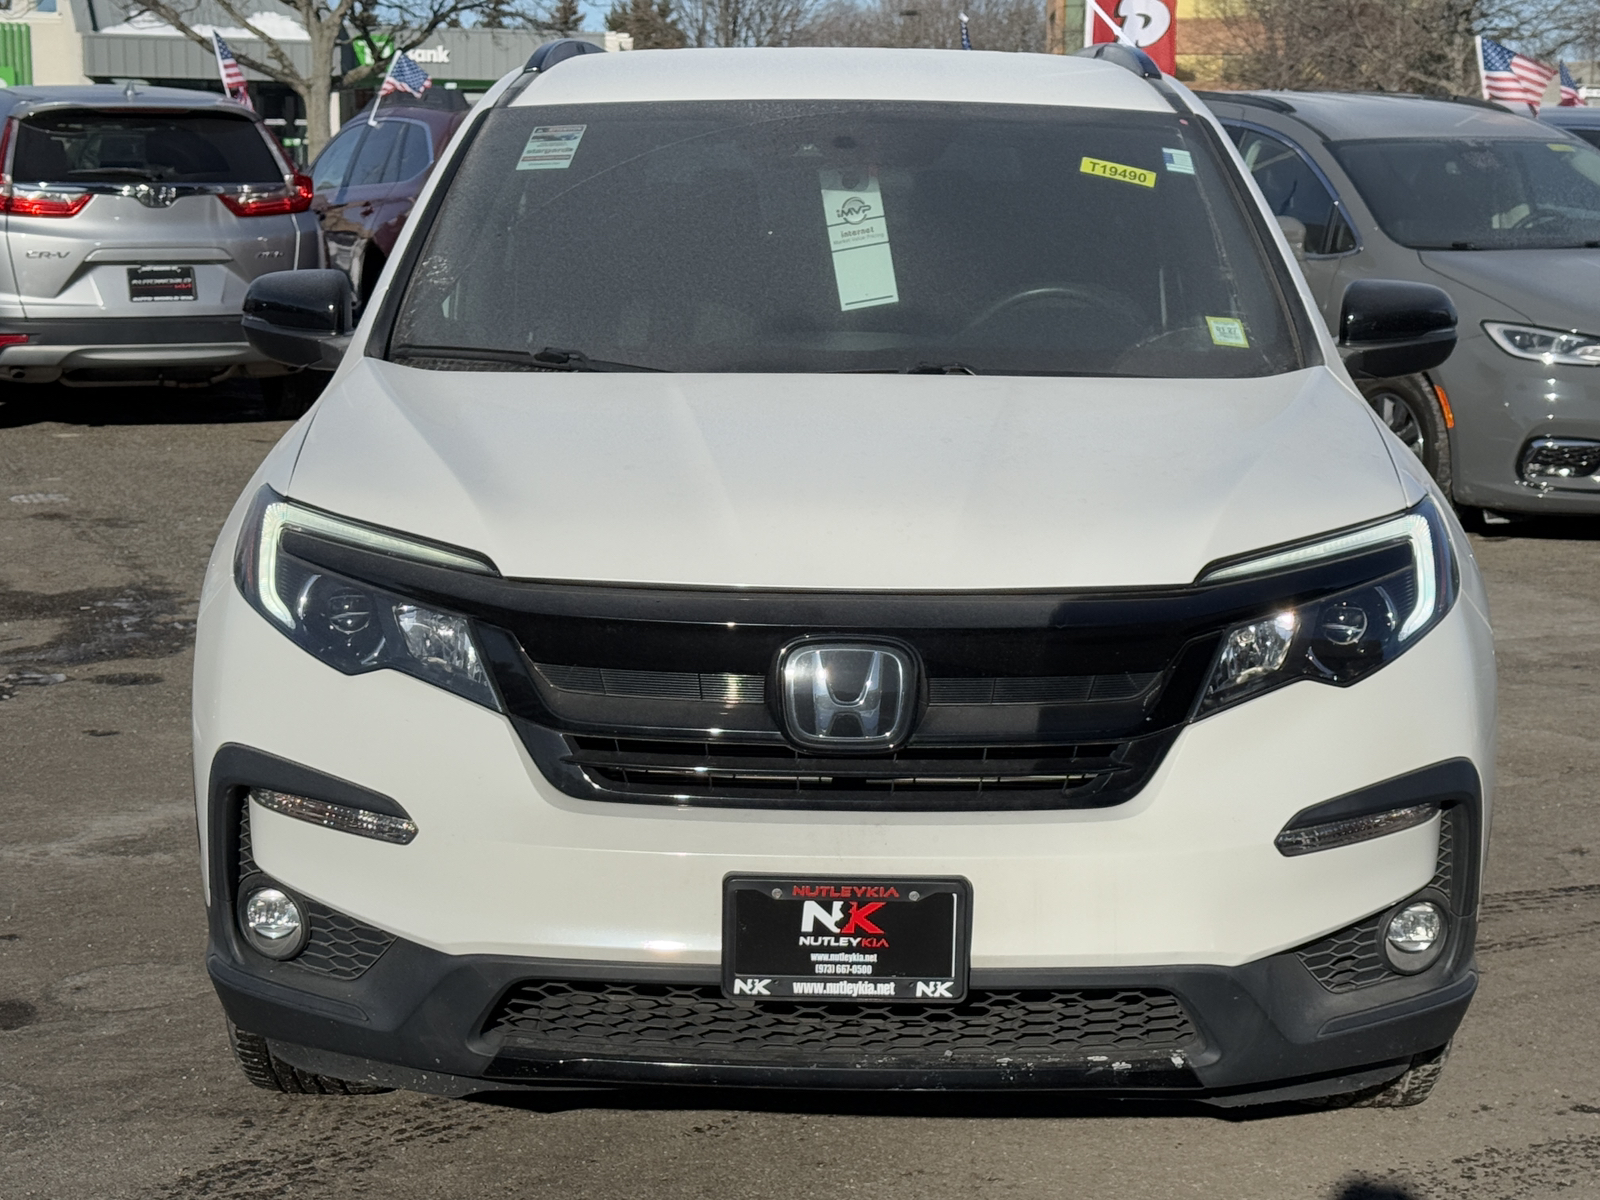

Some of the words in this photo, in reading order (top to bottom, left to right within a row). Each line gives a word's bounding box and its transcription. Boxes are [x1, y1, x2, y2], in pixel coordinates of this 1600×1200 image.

[1089, 161, 1147, 183] T19490
[841, 226, 875, 238] internet
[26, 250, 71, 259] CR-V
[792, 885, 900, 898] NUTLEYKIA
[798, 936, 889, 948] NUTLEYKIA
[810, 953, 878, 963] www.nutleykia.net
[815, 964, 835, 974] (973)
[835, 965, 873, 975] 667-0500
[793, 981, 895, 996] www.nutleykia.net
